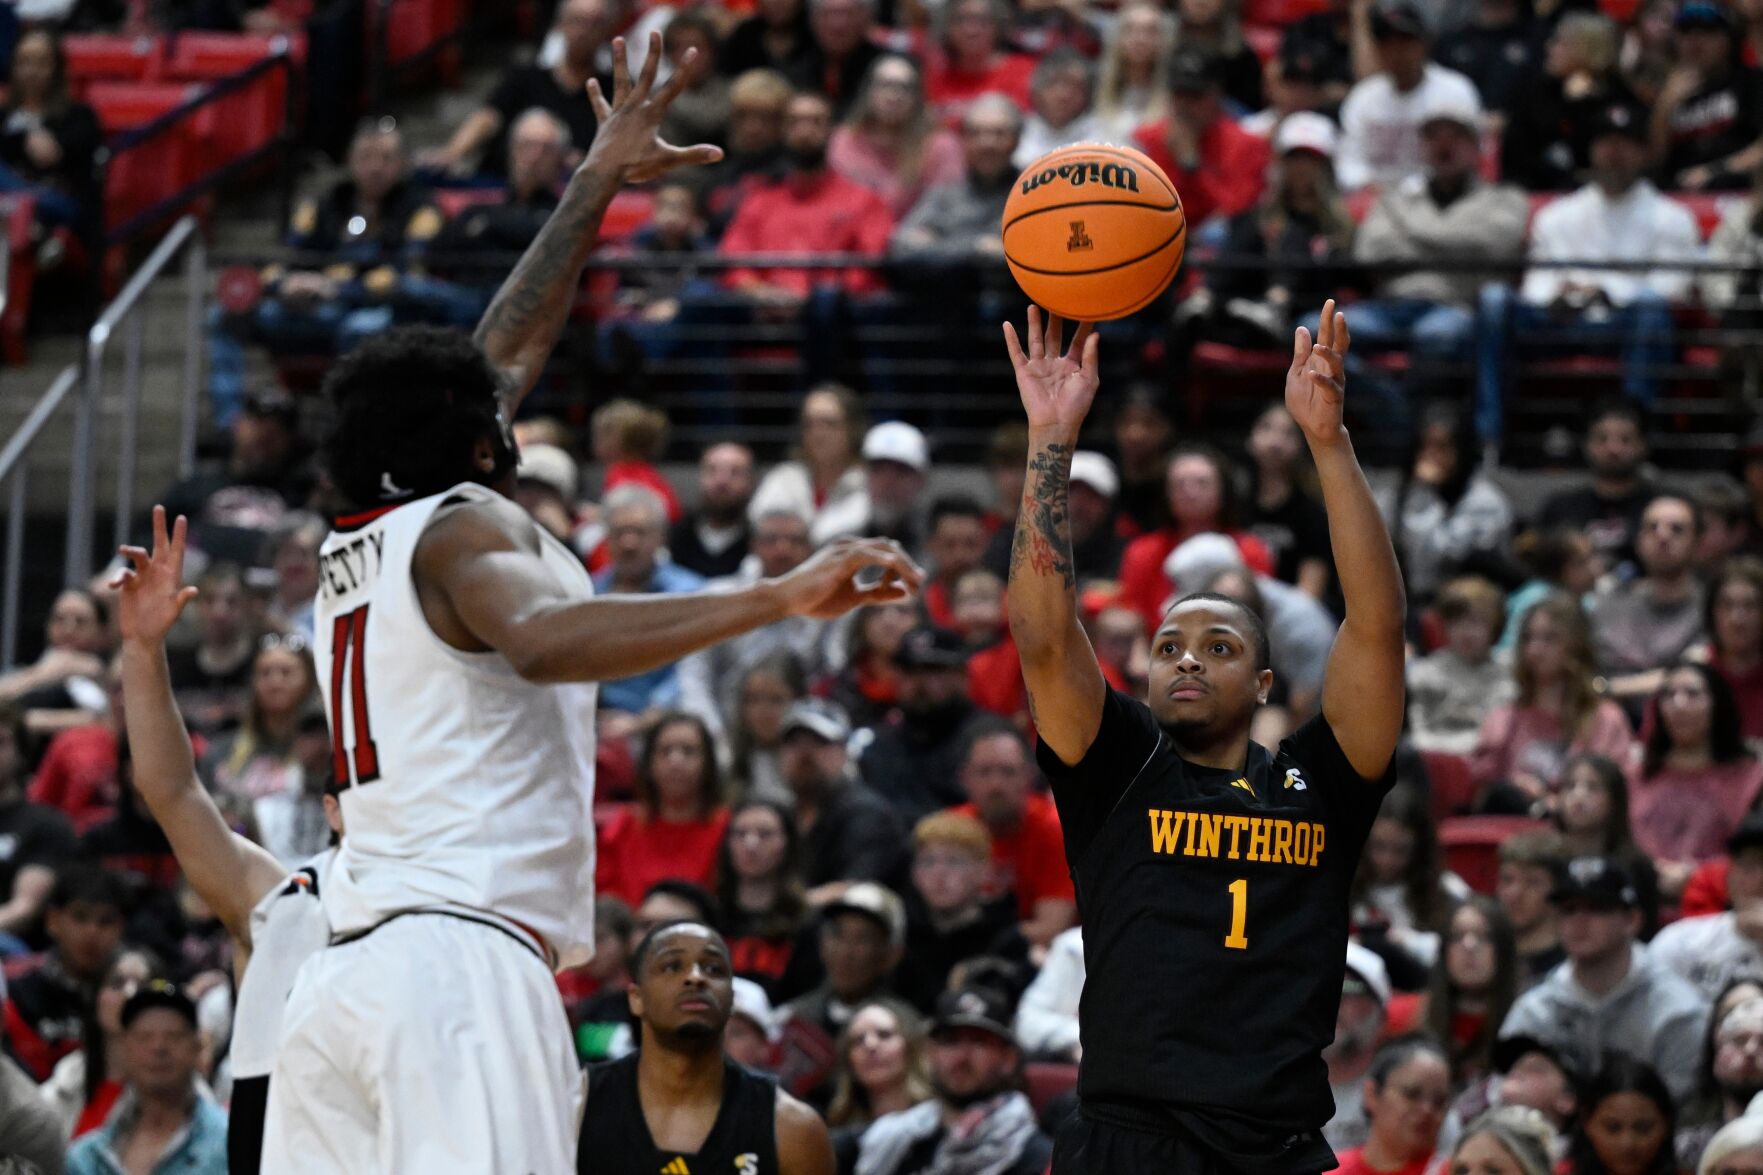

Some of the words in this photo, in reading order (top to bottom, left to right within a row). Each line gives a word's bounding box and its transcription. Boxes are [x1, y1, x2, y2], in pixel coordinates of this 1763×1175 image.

[1022, 162, 1139, 195] Wilson
[330, 602, 381, 787] 11
[1148, 809, 1326, 867] WINTHROP
[1224, 879, 1249, 950] 1
